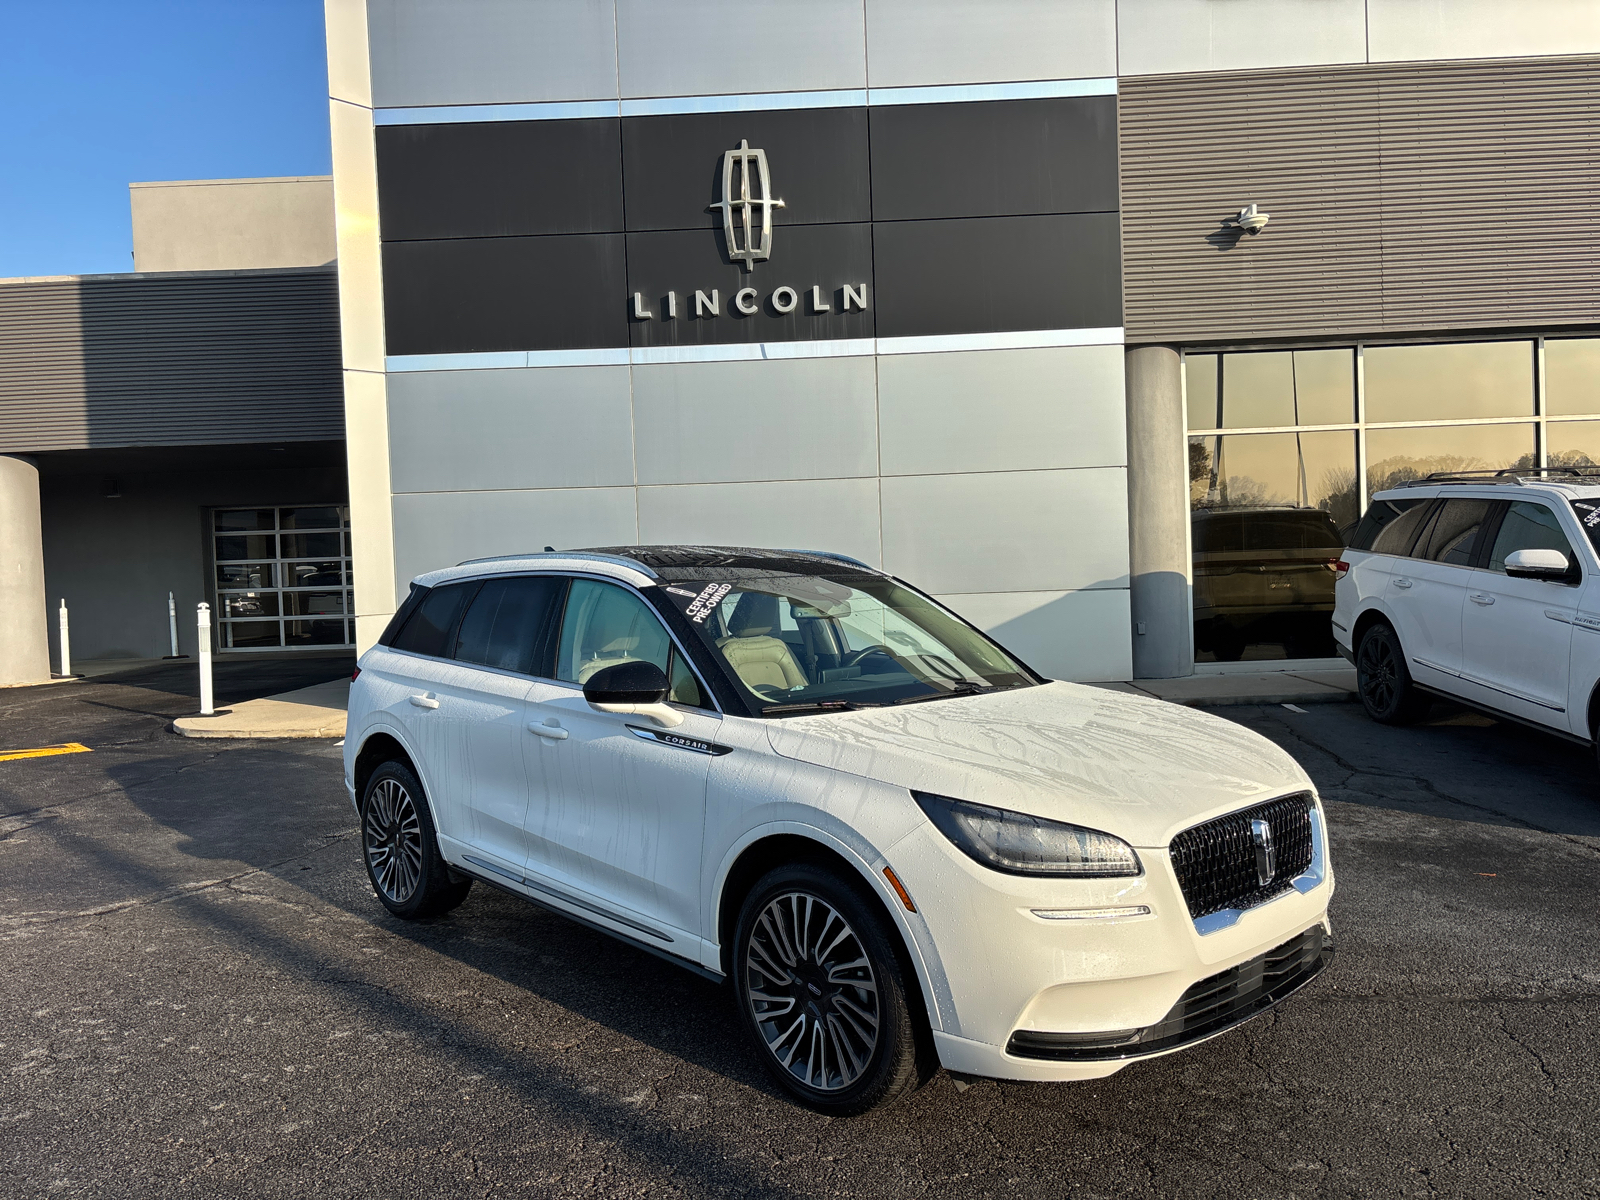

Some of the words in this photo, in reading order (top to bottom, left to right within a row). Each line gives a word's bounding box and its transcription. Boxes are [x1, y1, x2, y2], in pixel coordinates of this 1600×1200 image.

[634, 283, 867, 319] LINCOLN
[685, 582, 719, 615] CERTIFIED
[692, 583, 732, 623] PRE-OWNED
[665, 735, 708, 750] CORSAIR
